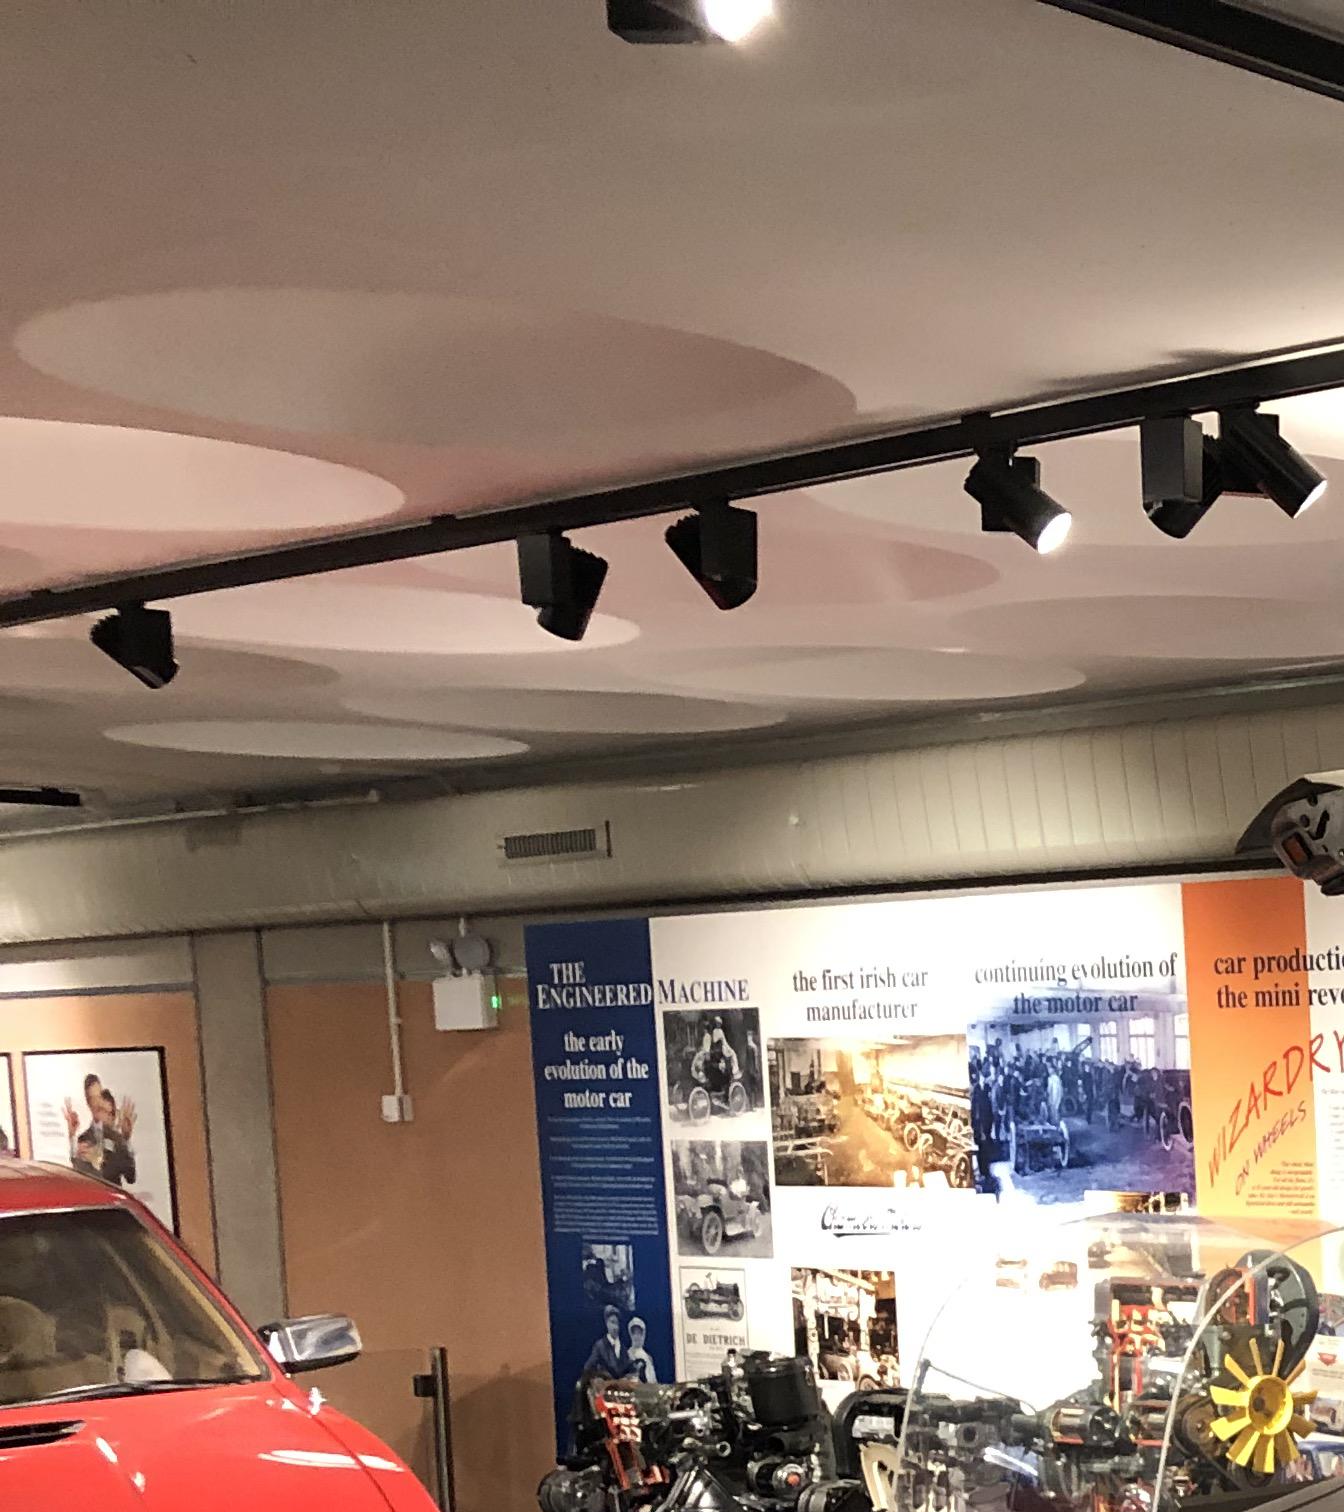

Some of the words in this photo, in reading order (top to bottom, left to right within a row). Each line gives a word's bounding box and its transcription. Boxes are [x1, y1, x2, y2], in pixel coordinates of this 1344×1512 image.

[550, 961, 586, 984] THE
[974, 957, 1067, 986] continuing
[1071, 954, 1154, 982] evolution
[1158, 952, 1179, 977] of
[1214, 955, 1246, 975] car
[792, 968, 818, 992] the
[821, 967, 855, 991] first
[858, 965, 897, 990] irish
[901, 967, 929, 988] car
[536, 983, 652, 1009] ENGINEERED
[657, 978, 750, 1004] MACHINE
[1012, 992, 1041, 1015] the
[1047, 993, 1101, 1014] motor
[1107, 993, 1139, 1013] car
[1217, 984, 1248, 1008] the
[1254, 981, 1301, 1007] mini
[805, 998, 918, 1022] manufacturer
[564, 1030, 586, 1052] the
[589, 1029, 624, 1056] early
[544, 1059, 606, 1081] evolution
[609, 1058, 624, 1080] of
[626, 1058, 649, 1079] the
[564, 1089, 606, 1109] motor
[609, 1091, 633, 1108] car
[1235, 1159, 1250, 1196] ON
[1252, 1099, 1308, 1165] WHEELS
[687, 1332, 698, 1345] DE
[703, 1332, 746, 1346] DIETRICH
